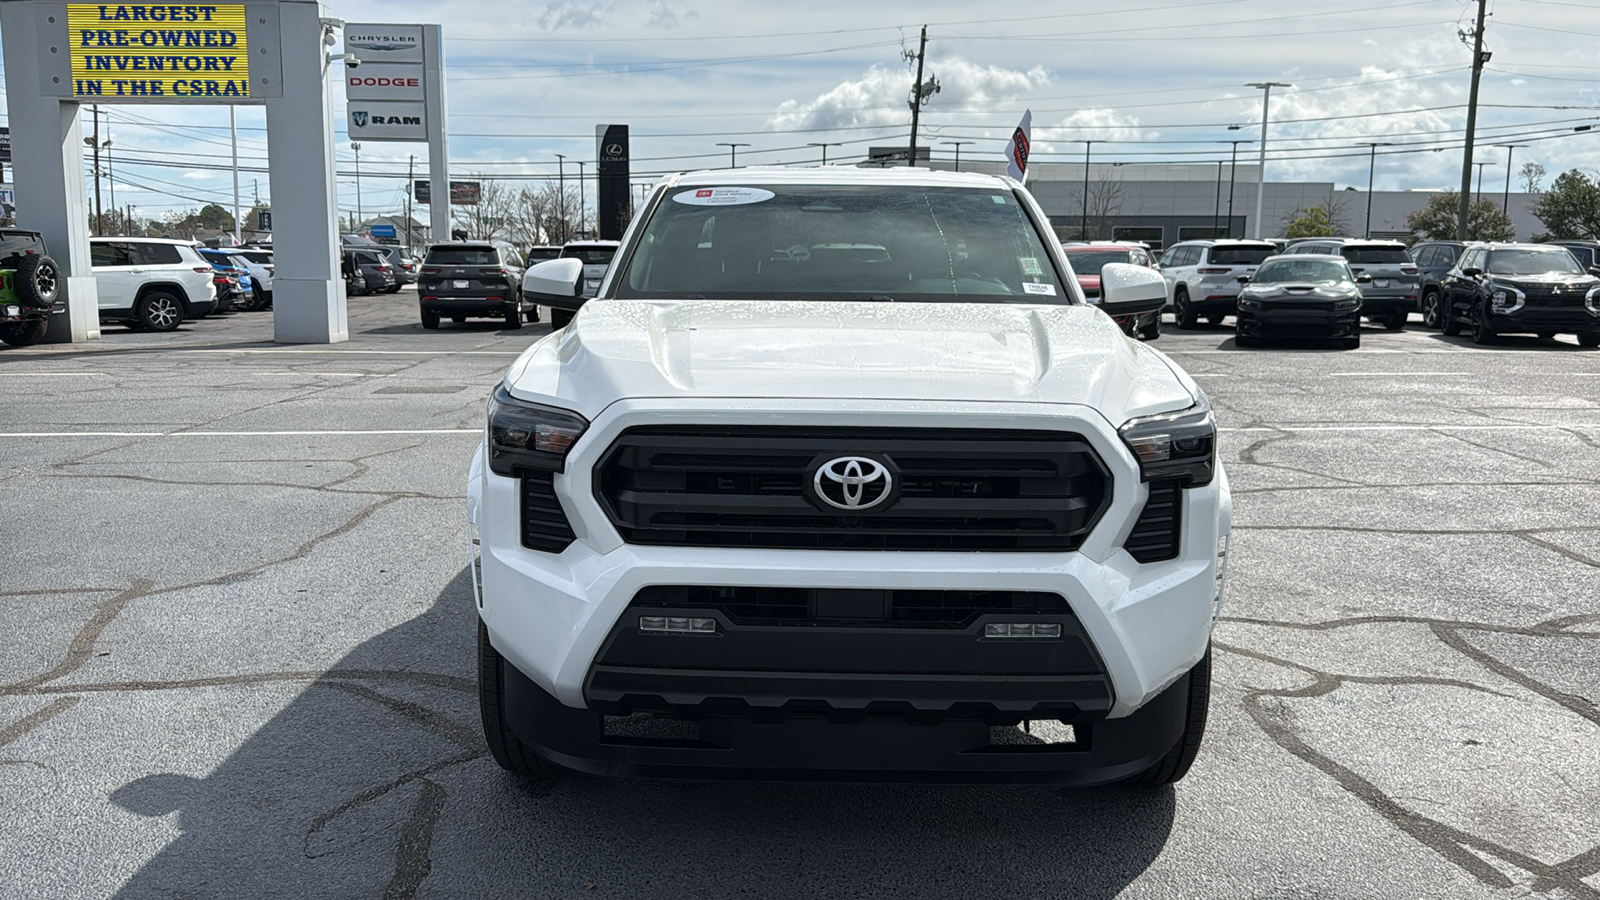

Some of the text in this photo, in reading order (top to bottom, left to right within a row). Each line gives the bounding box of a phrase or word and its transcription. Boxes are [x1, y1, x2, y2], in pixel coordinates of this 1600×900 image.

[98, 6, 216, 21] LARGEST
[80, 30, 237, 47] PRE-OWNED
[84, 56, 237, 71] INVENTORY
[75, 80, 249, 96] IN THE CSRA!
[349, 77, 419, 87] DODGE
[371, 116, 421, 126] RAM
